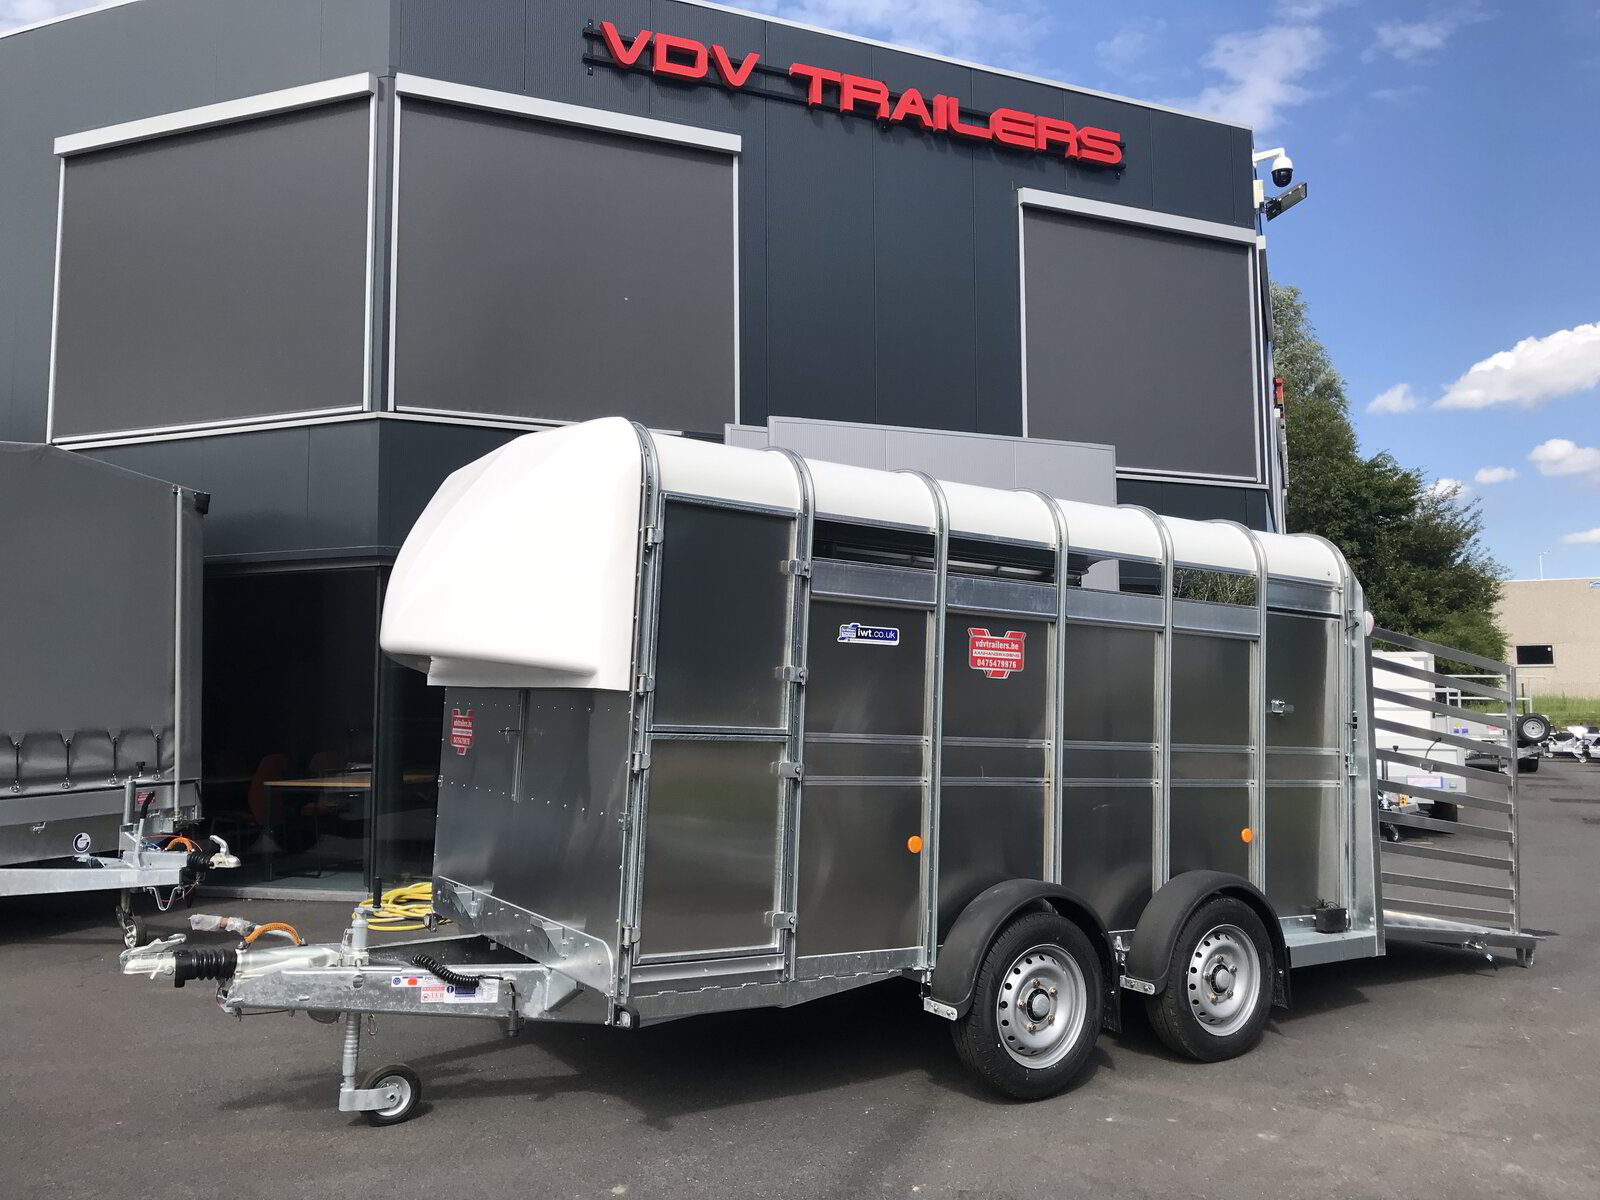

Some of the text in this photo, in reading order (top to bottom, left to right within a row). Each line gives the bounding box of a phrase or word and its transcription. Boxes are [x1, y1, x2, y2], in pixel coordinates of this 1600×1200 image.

[601, 21, 1123, 166] VDV TRAILERS
[857, 628, 896, 639] iwt.co.uk
[975, 640, 1019, 650] vdvtrailers.be
[976, 659, 1017, 669] 0475479976
